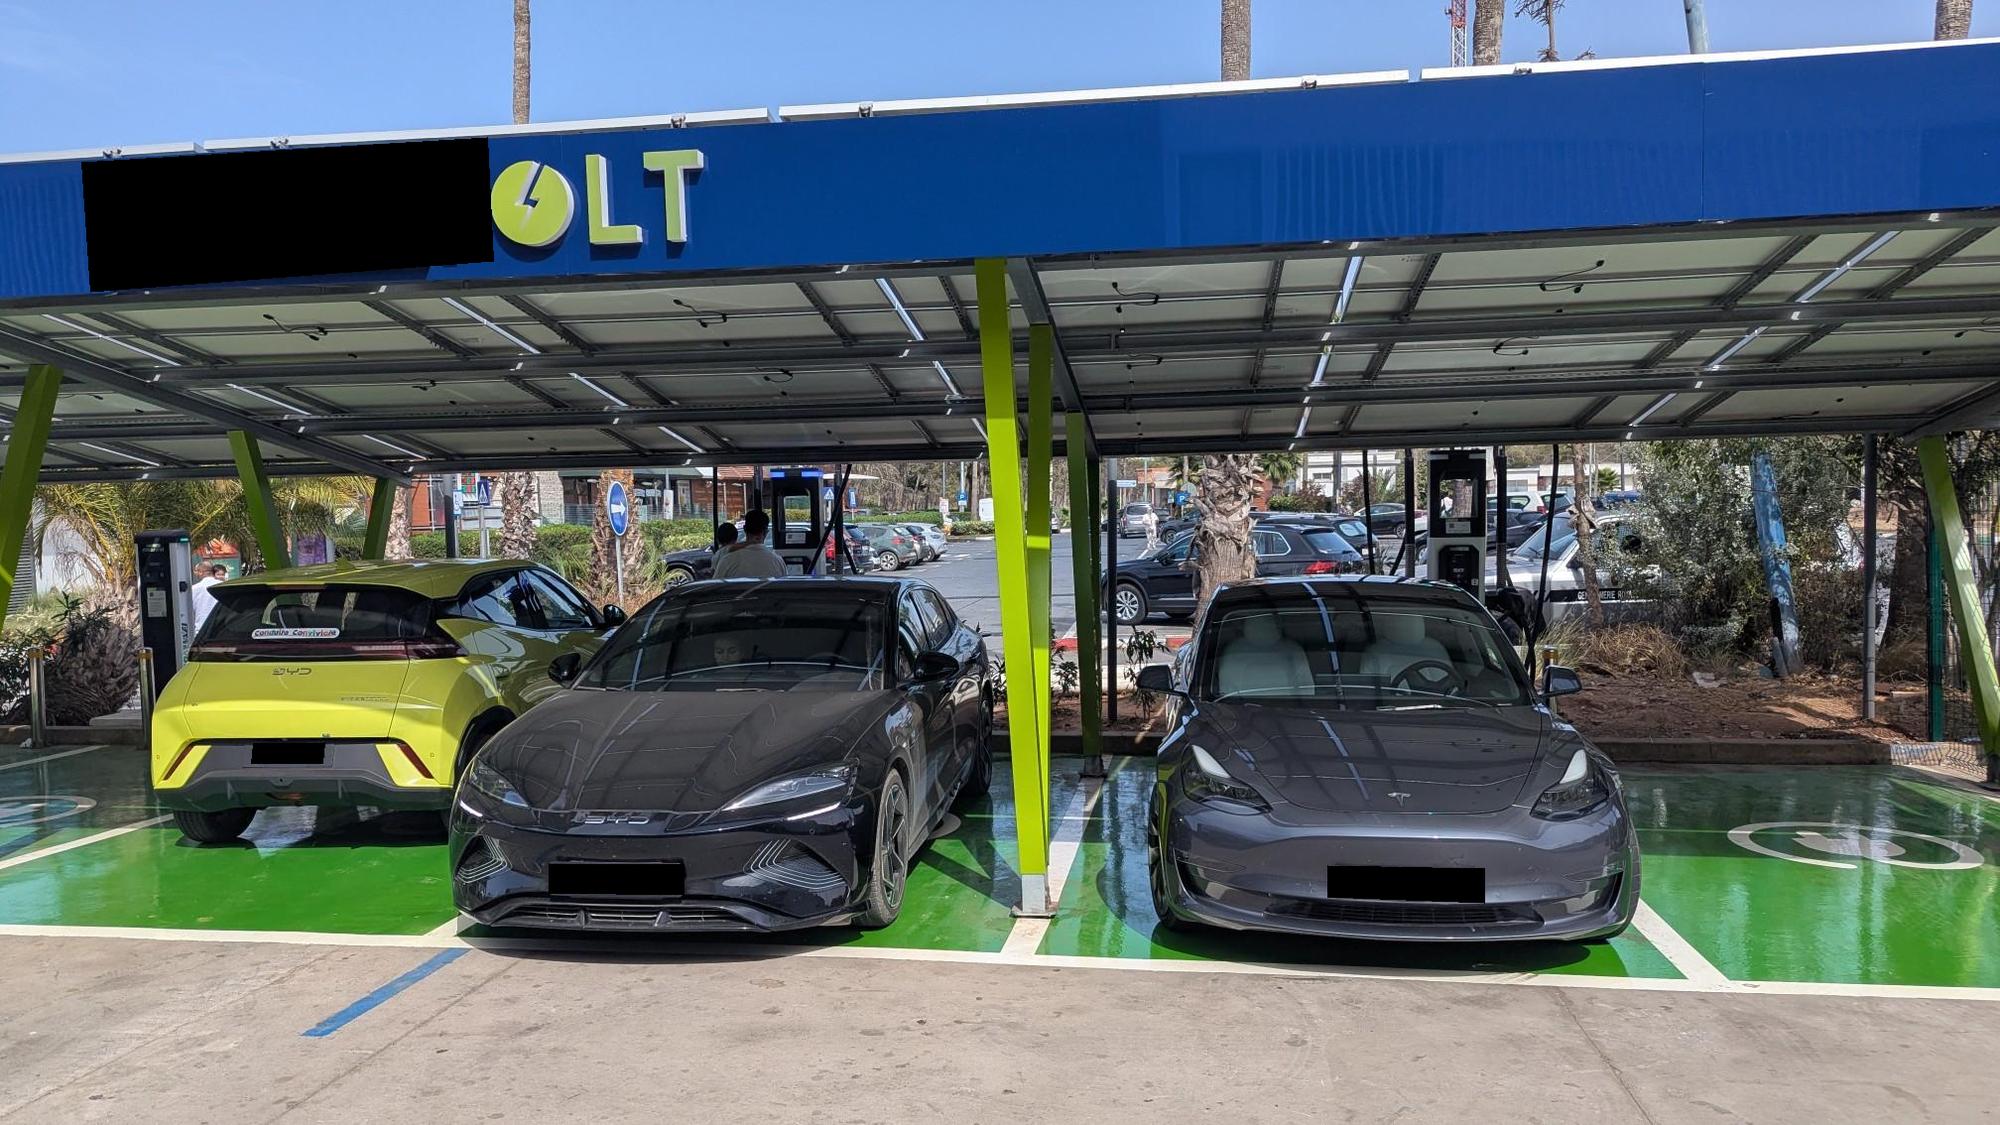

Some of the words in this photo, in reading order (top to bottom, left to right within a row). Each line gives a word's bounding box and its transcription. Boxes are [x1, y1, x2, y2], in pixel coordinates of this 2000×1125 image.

[1577, 590, 1616, 600] GEMERIE
[272, 667, 313, 676] BYD
[584, 815, 650, 824] BYD
